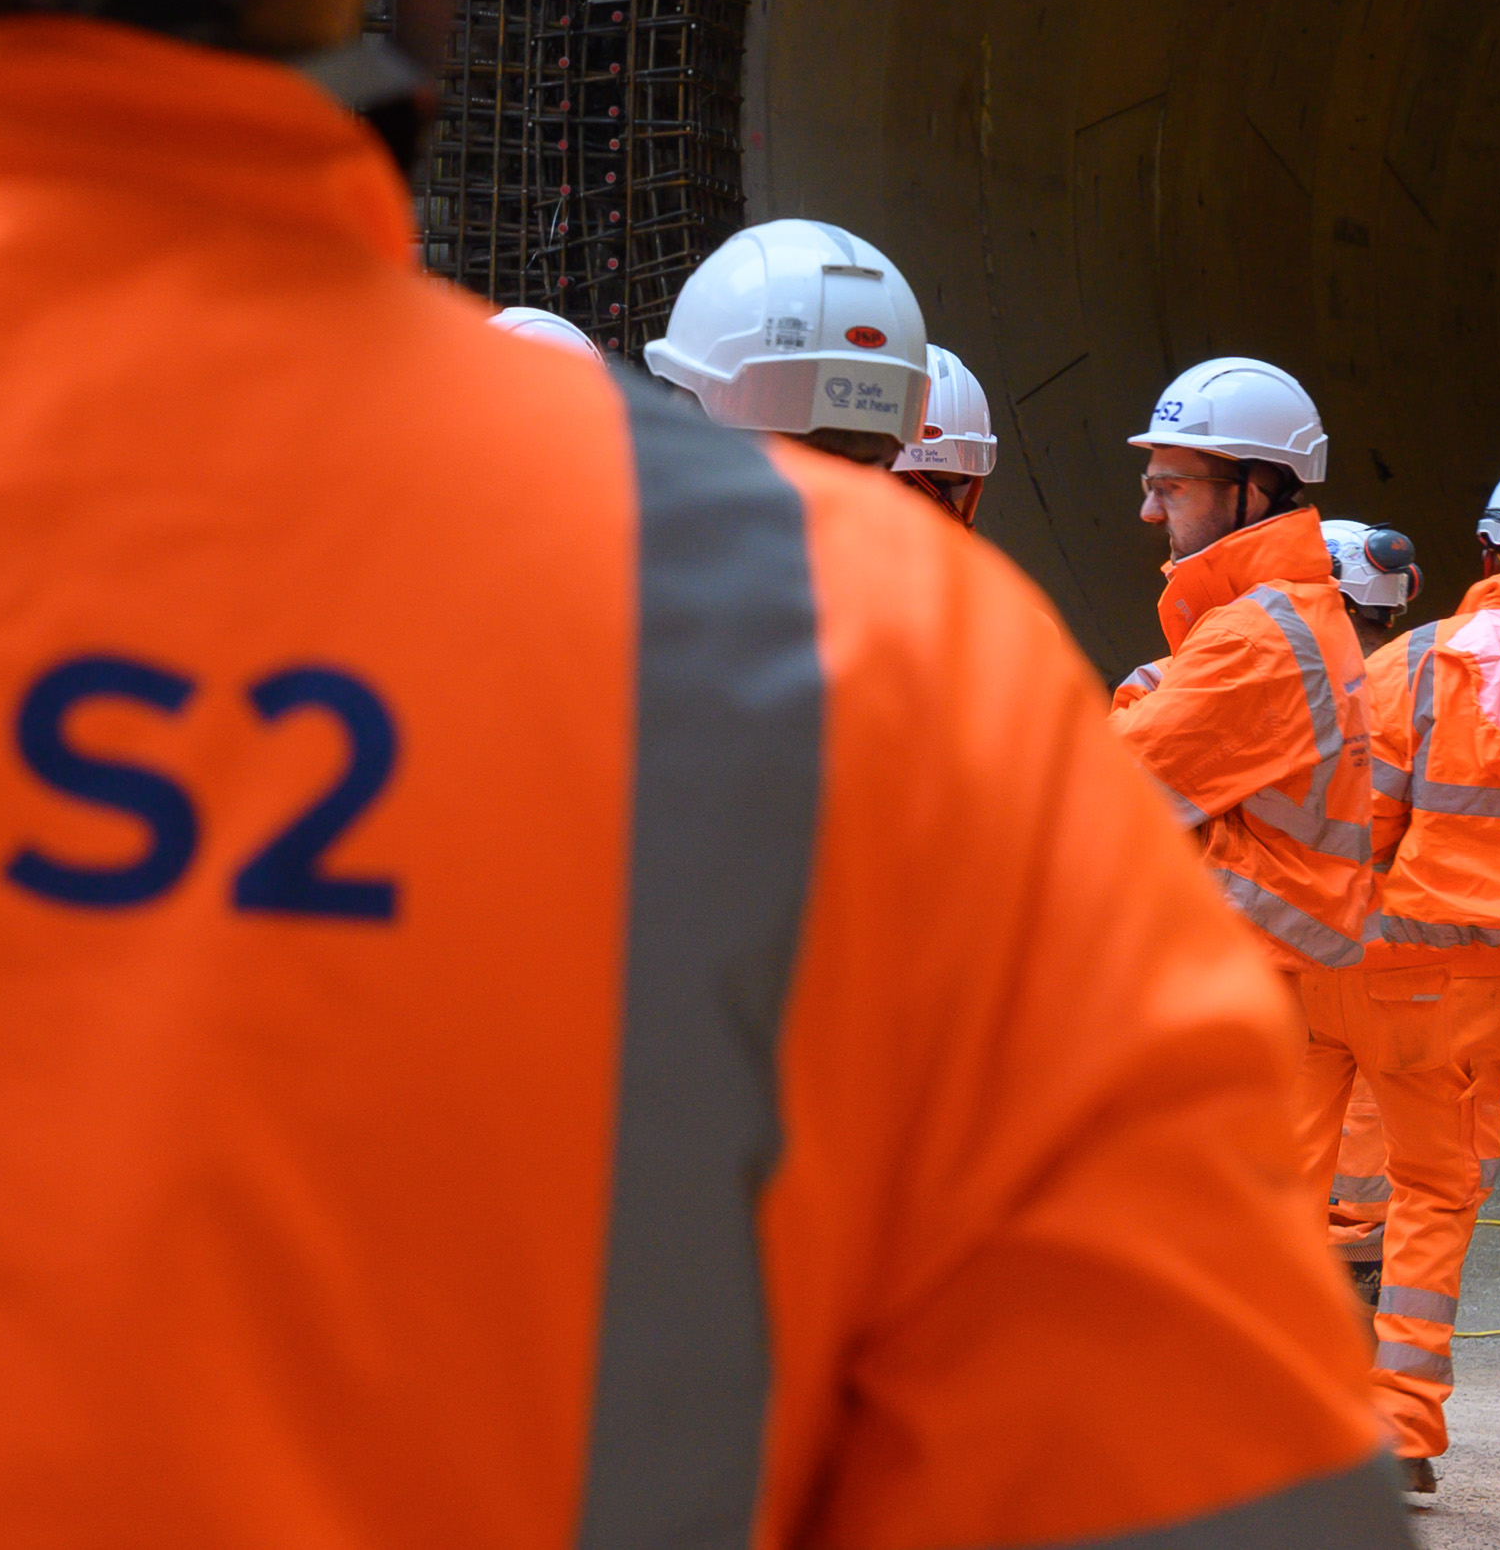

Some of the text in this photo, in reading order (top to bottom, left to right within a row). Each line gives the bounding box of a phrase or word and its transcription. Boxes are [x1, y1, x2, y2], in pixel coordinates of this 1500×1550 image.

[857, 382, 883, 398] Safe
[855, 400, 899, 415] at heart
[924, 449, 938, 457] Safe
